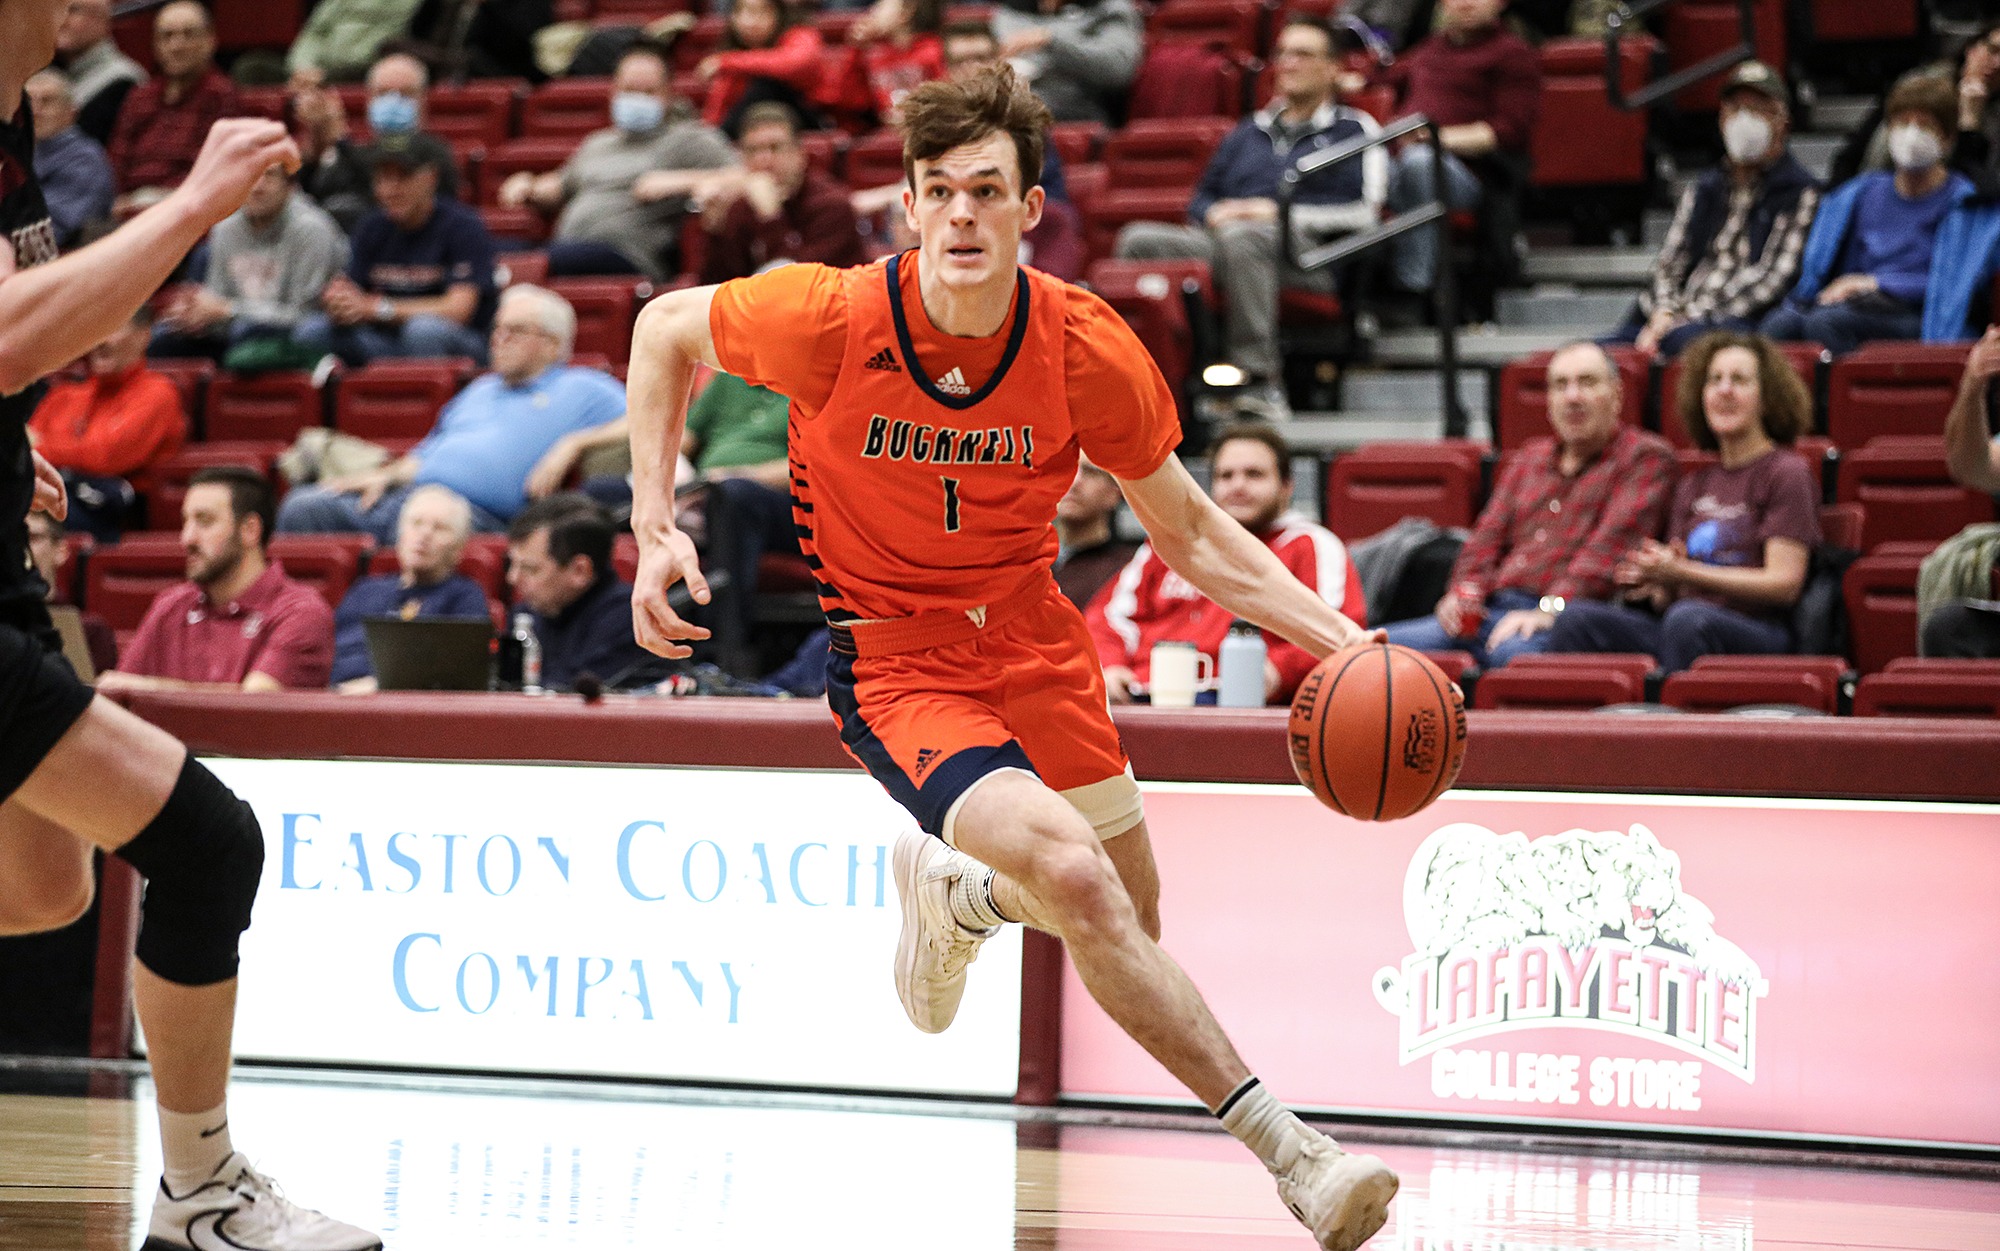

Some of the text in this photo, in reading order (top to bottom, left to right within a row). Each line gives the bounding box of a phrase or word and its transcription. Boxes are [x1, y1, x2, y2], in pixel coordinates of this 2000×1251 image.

[864, 361, 902, 373] adidas
[861, 414, 1035, 470] BUCKNELL
[939, 475, 960, 534] 1
[915, 749, 943, 778] adidas
[279, 812, 888, 908] EASTON COACH
[391, 931, 756, 1024] COMPANY
[1412, 943, 1745, 1058] LAFAYETTE
[1431, 1048, 1702, 1112] COLLEGE STORE
